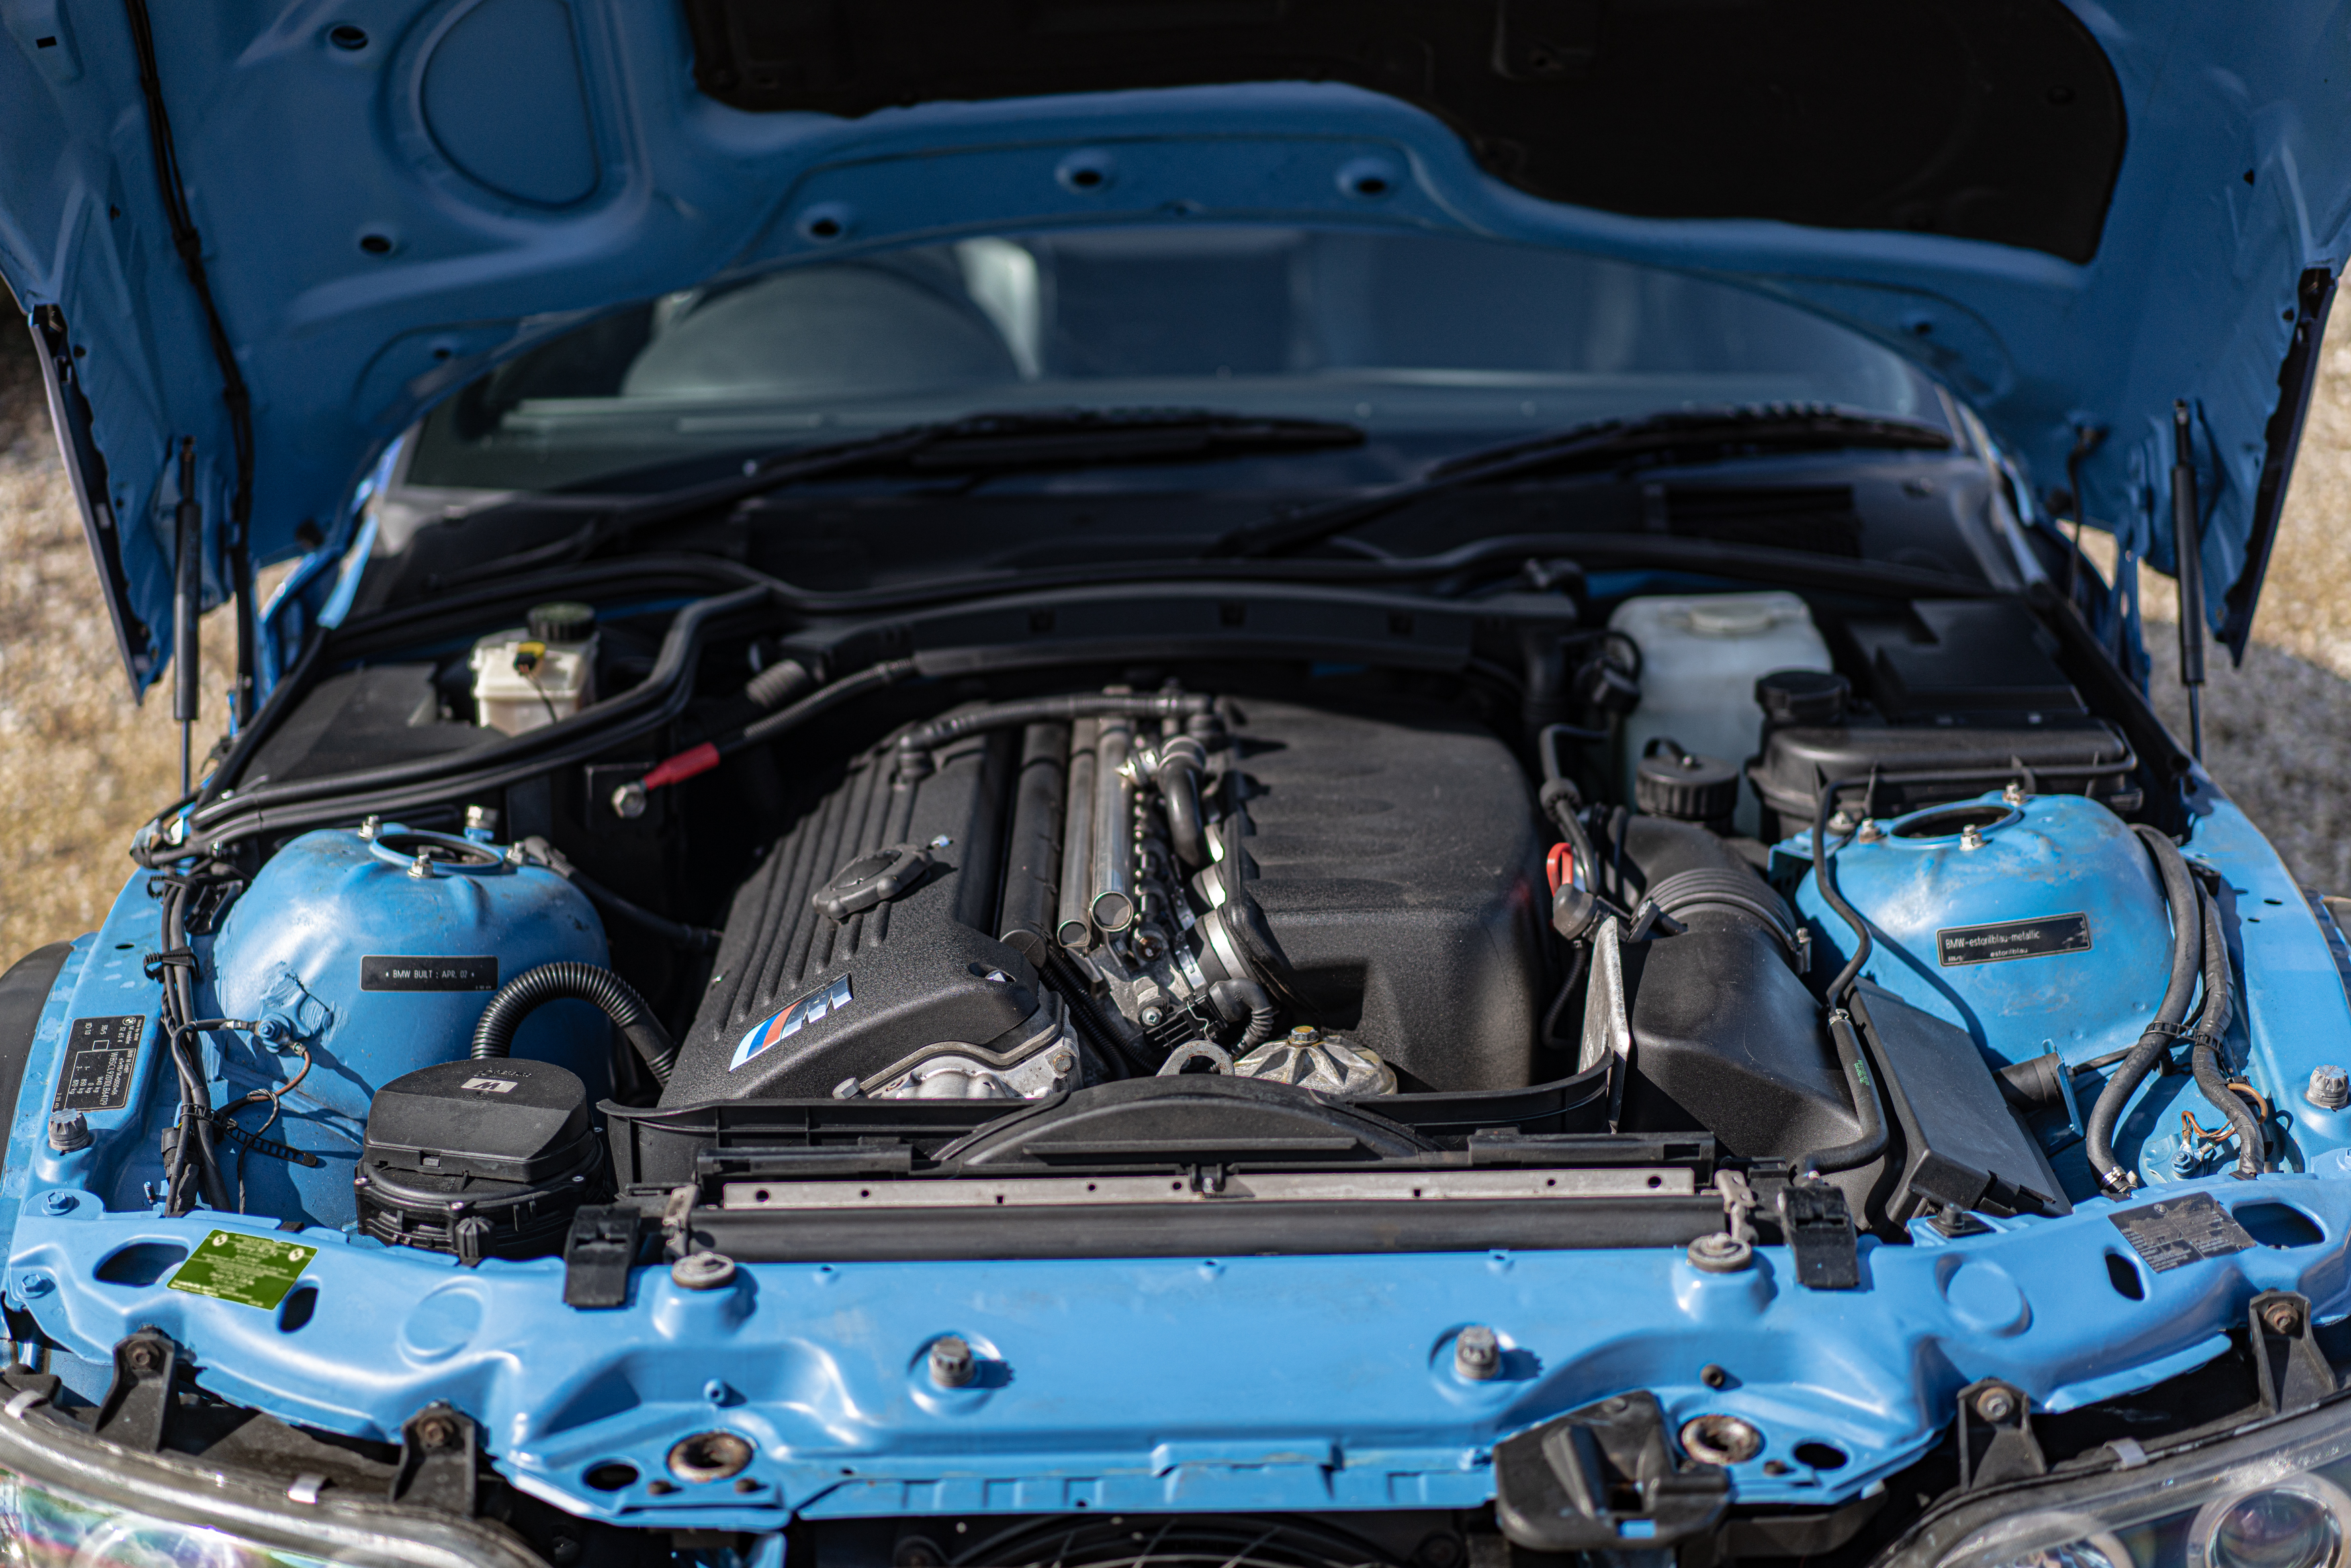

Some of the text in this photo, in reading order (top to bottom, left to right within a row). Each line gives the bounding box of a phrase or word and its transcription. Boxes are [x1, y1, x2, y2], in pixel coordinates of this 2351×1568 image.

[1990, 947, 2028, 958] estorilblau
[393, 970, 410, 978] BMW
[414, 970, 432, 978] BUILT
[442, 970, 457, 978] APR.
[472, 1082, 500, 1090] M
